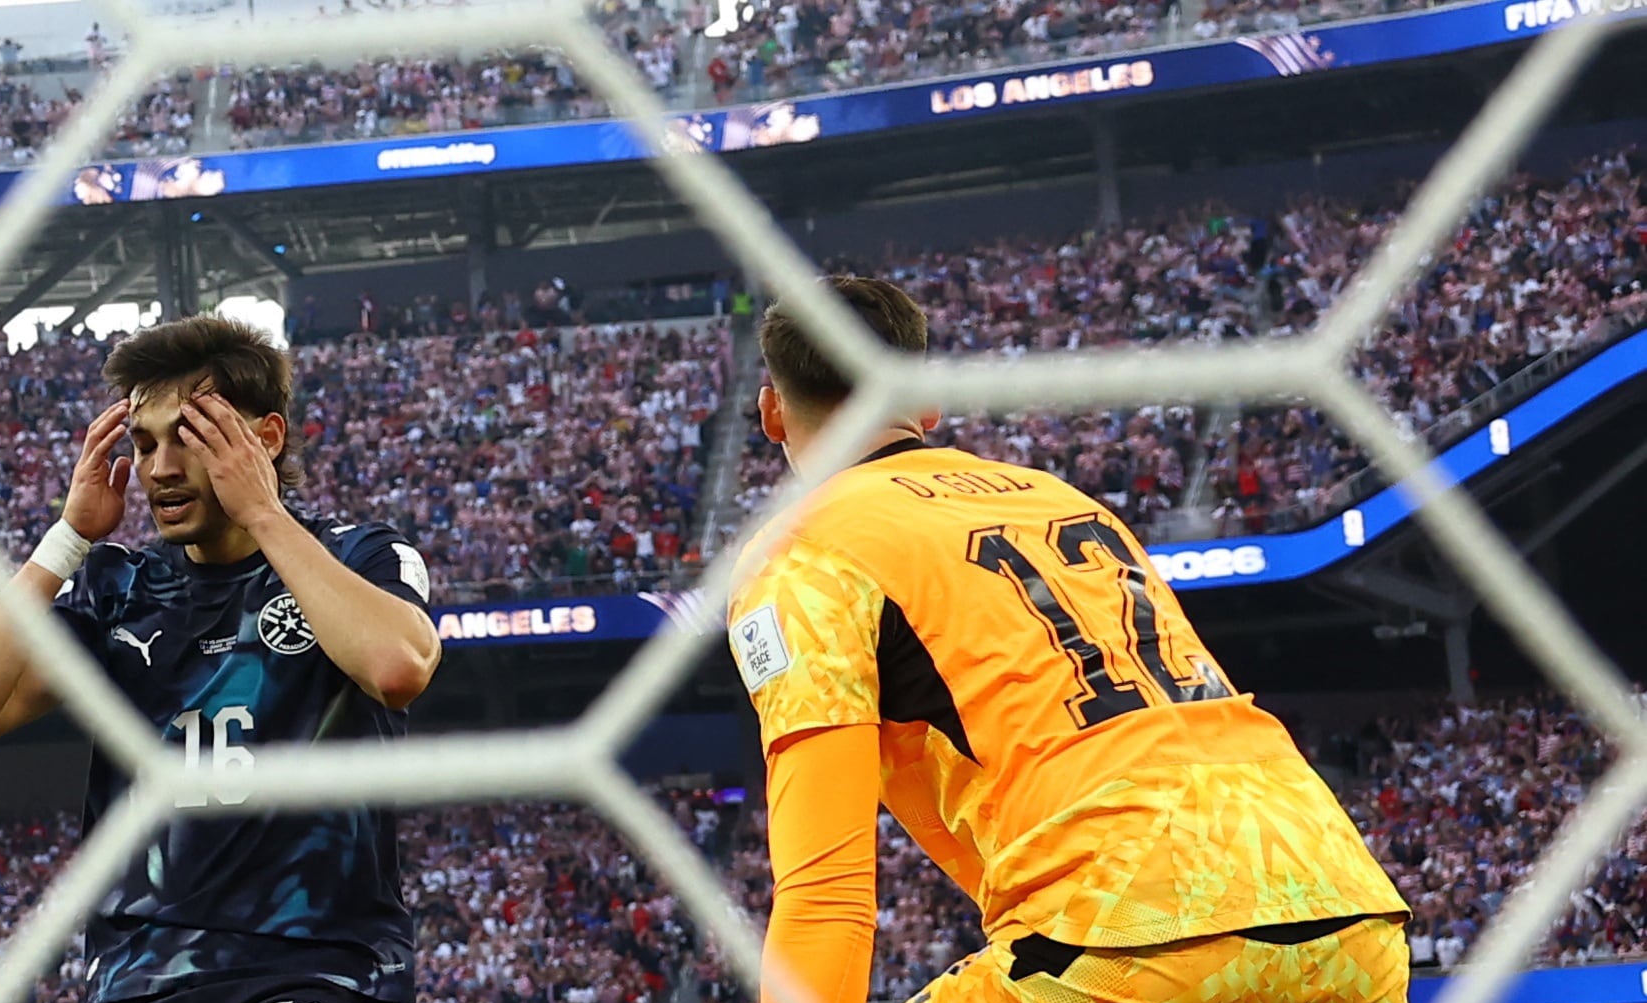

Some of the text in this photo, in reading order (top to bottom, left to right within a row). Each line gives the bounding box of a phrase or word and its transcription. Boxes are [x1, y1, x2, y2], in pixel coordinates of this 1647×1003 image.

[1505, 0, 1575, 31] FIFA
[930, 60, 1153, 113] LOS ANGELES
[933, 472, 1034, 494] GILL
[438, 605, 596, 640] ANGELES
[965, 512, 1238, 730] 12
[750, 649, 772, 672] PEACE
[171, 705, 255, 808] 16
